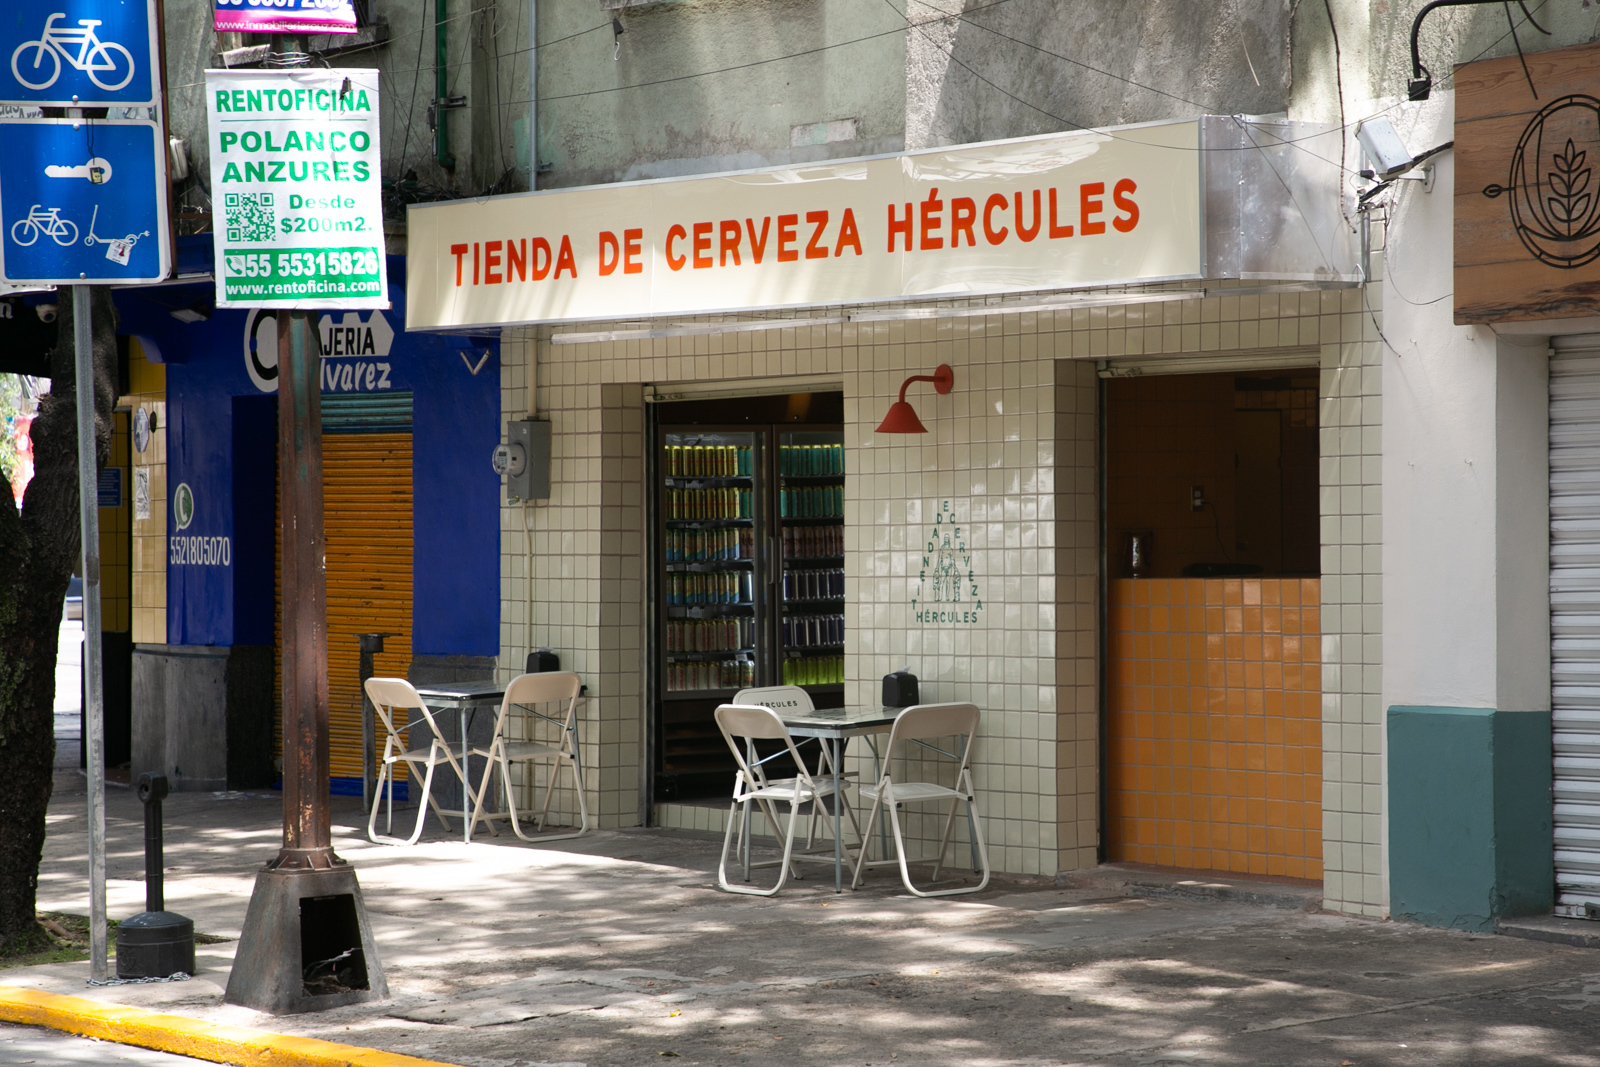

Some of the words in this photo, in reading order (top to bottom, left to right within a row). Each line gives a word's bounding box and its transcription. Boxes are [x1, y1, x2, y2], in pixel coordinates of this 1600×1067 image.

[216, 89, 370, 112] RENTOFICINA
[220, 131, 370, 153] POLANCO
[221, 161, 370, 183] ANZURES
[289, 194, 355, 209] Desde
[281, 217, 372, 235] $200m2.
[451, 235, 578, 287] TIENDA
[599, 228, 643, 277] DE
[665, 208, 863, 272] CERVEZA
[887, 178, 1140, 253] HÉRCULES
[246, 254, 272, 277] 55
[278, 251, 378, 277] 55315826
[226, 280, 380, 295] www.rentoficina.com
[320, 358, 391, 391] lvarez
[170, 536, 231, 566] 5521805070
[916, 609, 978, 623] HÉRCULES
[754, 700, 798, 708] ÉRCULES
